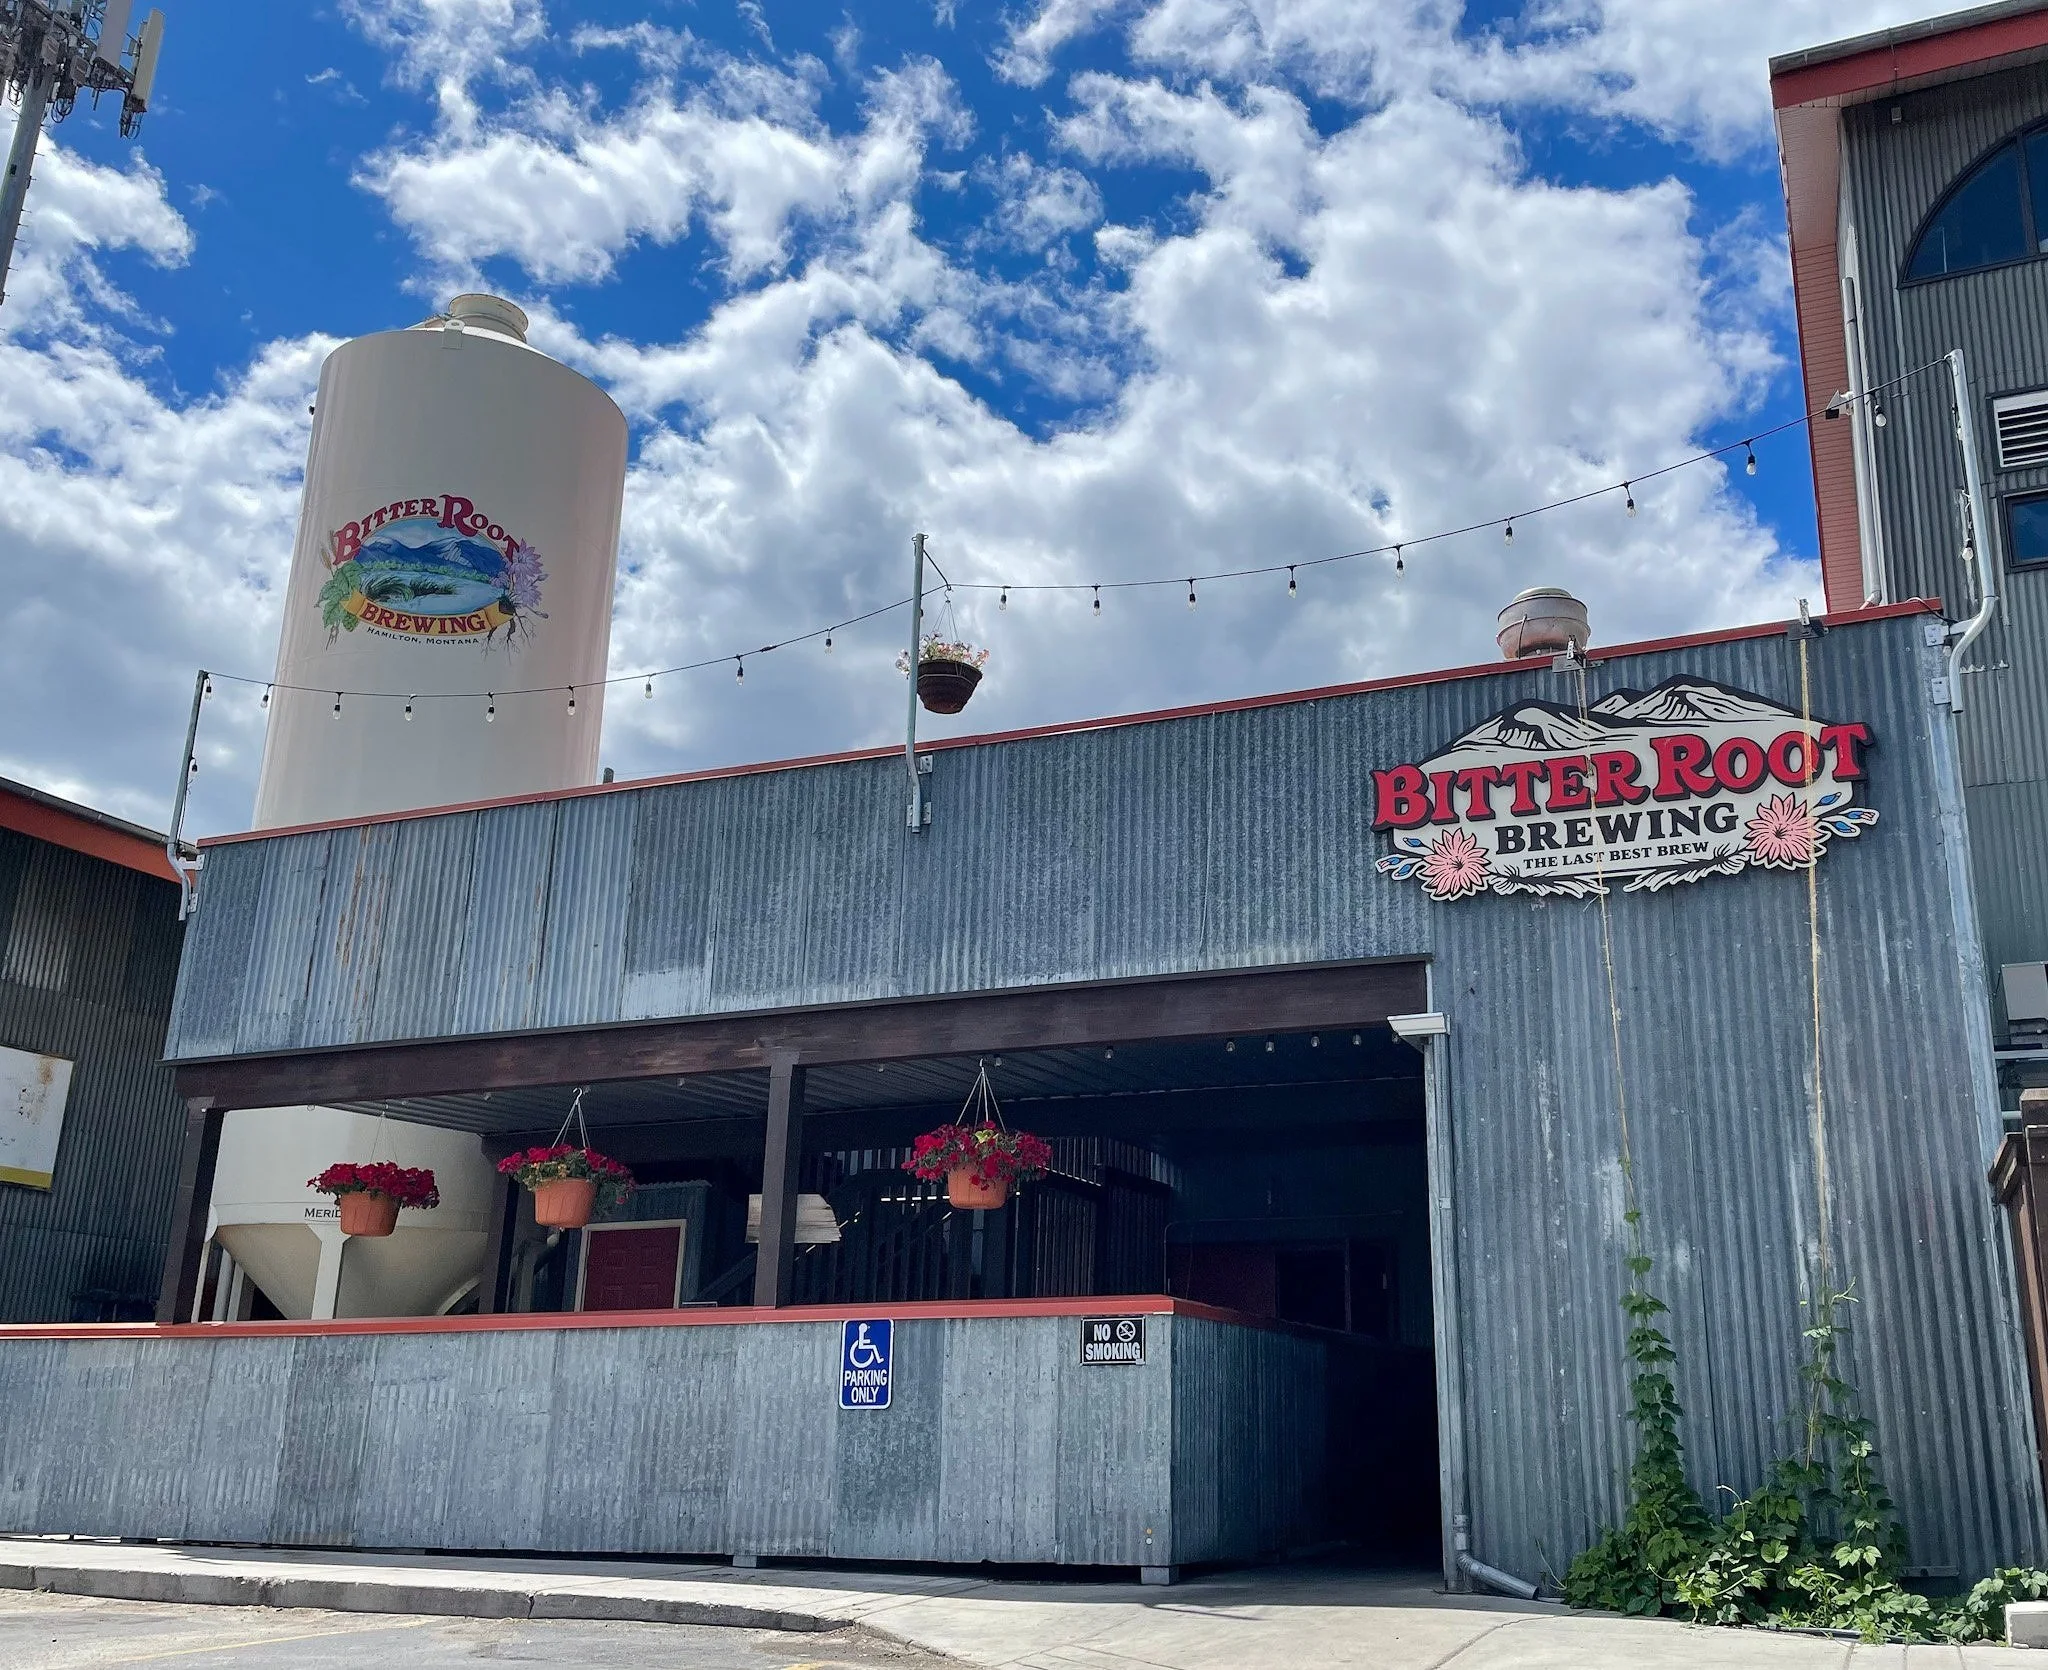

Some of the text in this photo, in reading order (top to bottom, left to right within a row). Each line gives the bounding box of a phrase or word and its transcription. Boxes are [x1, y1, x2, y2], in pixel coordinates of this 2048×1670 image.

[332, 494, 521, 566] BITTER ROOT
[360, 602, 487, 634] BREWING
[367, 627, 480, 645] HAMILTON, MONTANA
[1371, 722, 1873, 832] BITTER ROOT
[1494, 802, 1739, 855] BREWING
[1523, 841, 1709, 869] THE LAST BEST BREW
[1093, 1323, 1111, 1341] NO
[1085, 1342, 1141, 1360] SMOKING
[844, 1369, 888, 1387] PARKING
[850, 1386, 880, 1404] ONLY
